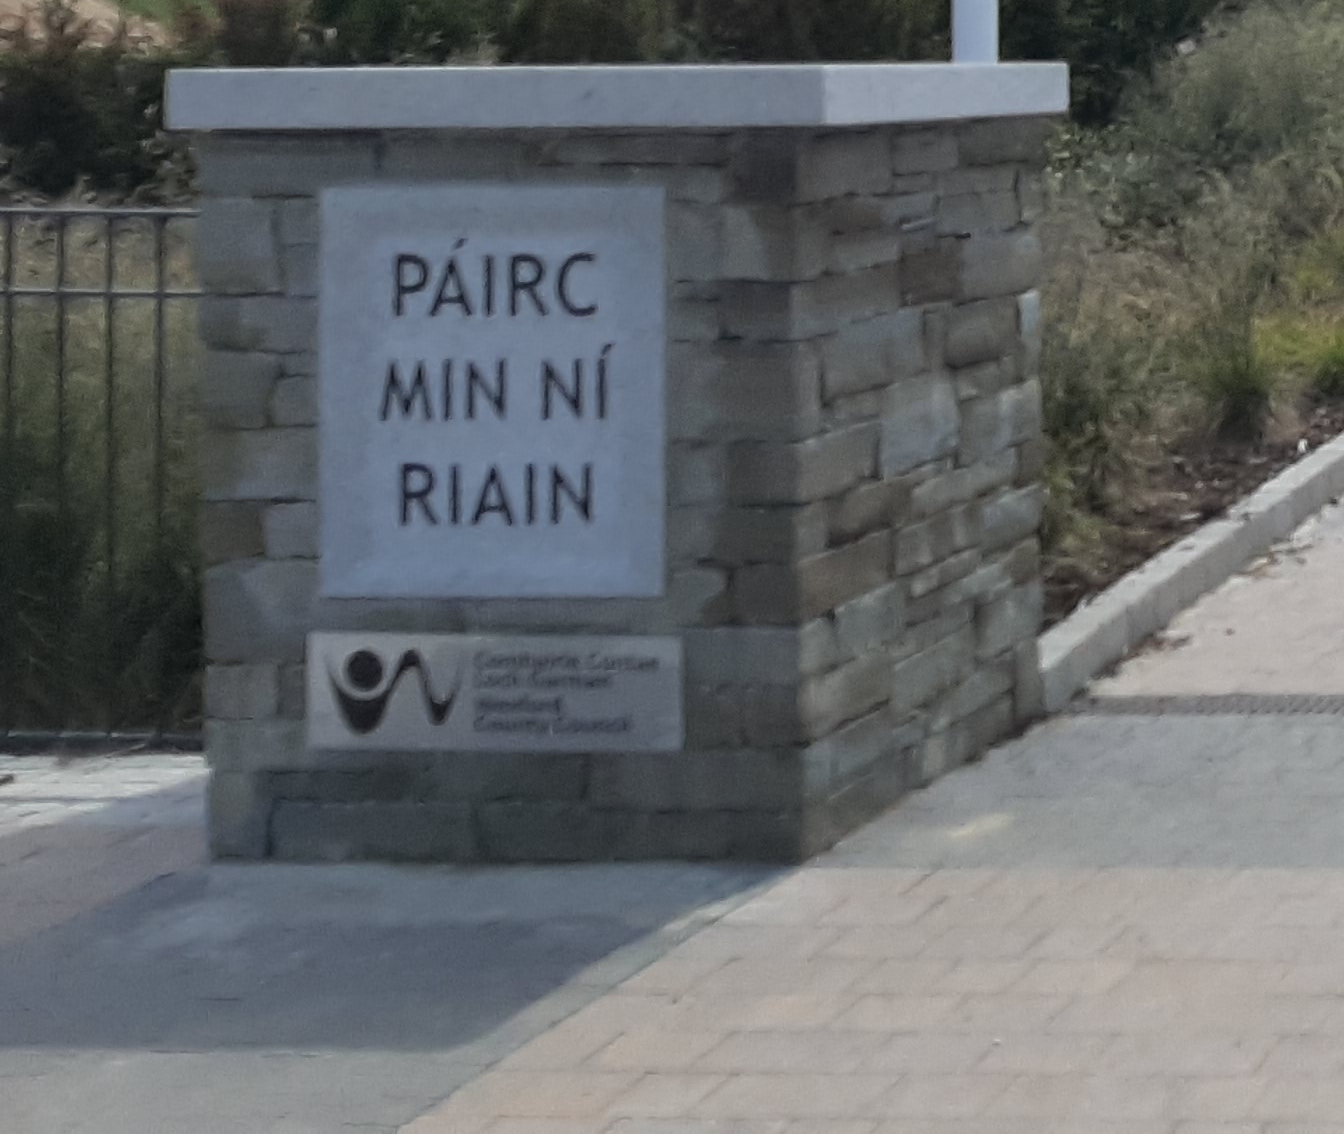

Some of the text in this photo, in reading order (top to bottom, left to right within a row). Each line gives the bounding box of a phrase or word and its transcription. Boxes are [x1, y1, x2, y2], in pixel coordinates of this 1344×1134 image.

[392, 237, 598, 317] PÁIRC
[379, 342, 616, 422] MIN NÍ
[399, 462, 595, 527] RIAIN
